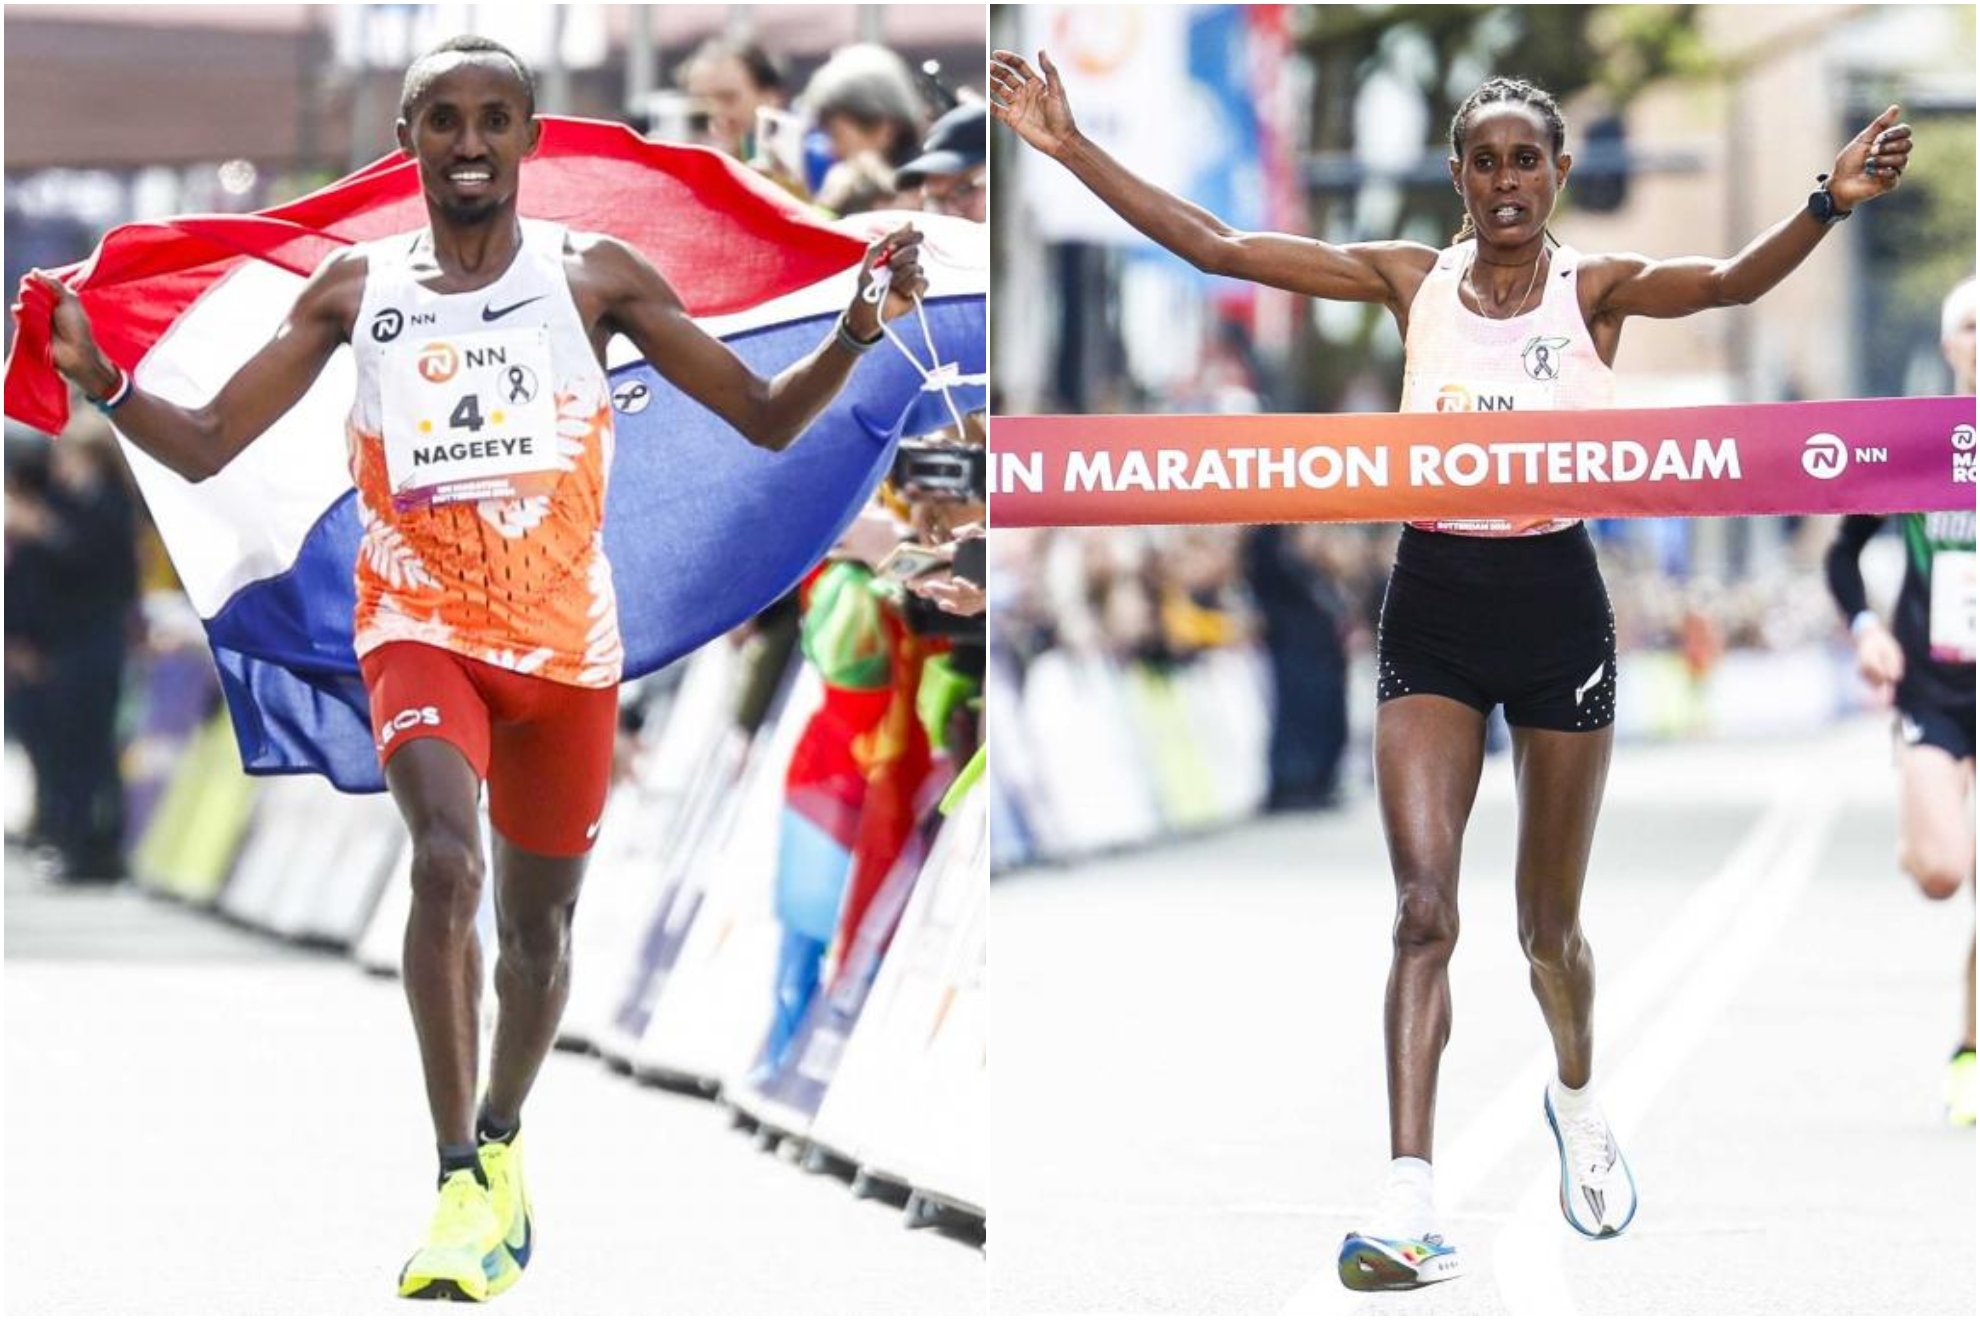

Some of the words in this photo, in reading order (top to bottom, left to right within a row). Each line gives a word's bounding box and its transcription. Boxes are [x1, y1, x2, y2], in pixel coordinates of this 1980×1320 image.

[411, 313, 436, 325] NN
[466, 347, 507, 368] NN
[449, 394, 484, 432] 4
[1477, 395, 1514, 411] NN
[413, 437, 533, 466] NAGEEYE
[1855, 448, 1888, 462] NN
[990, 451, 1043, 493] N
[1064, 445, 1388, 491] MARATHON
[1409, 438, 1742, 486] ROTTERDAM
[377, 706, 441, 750] EOS
